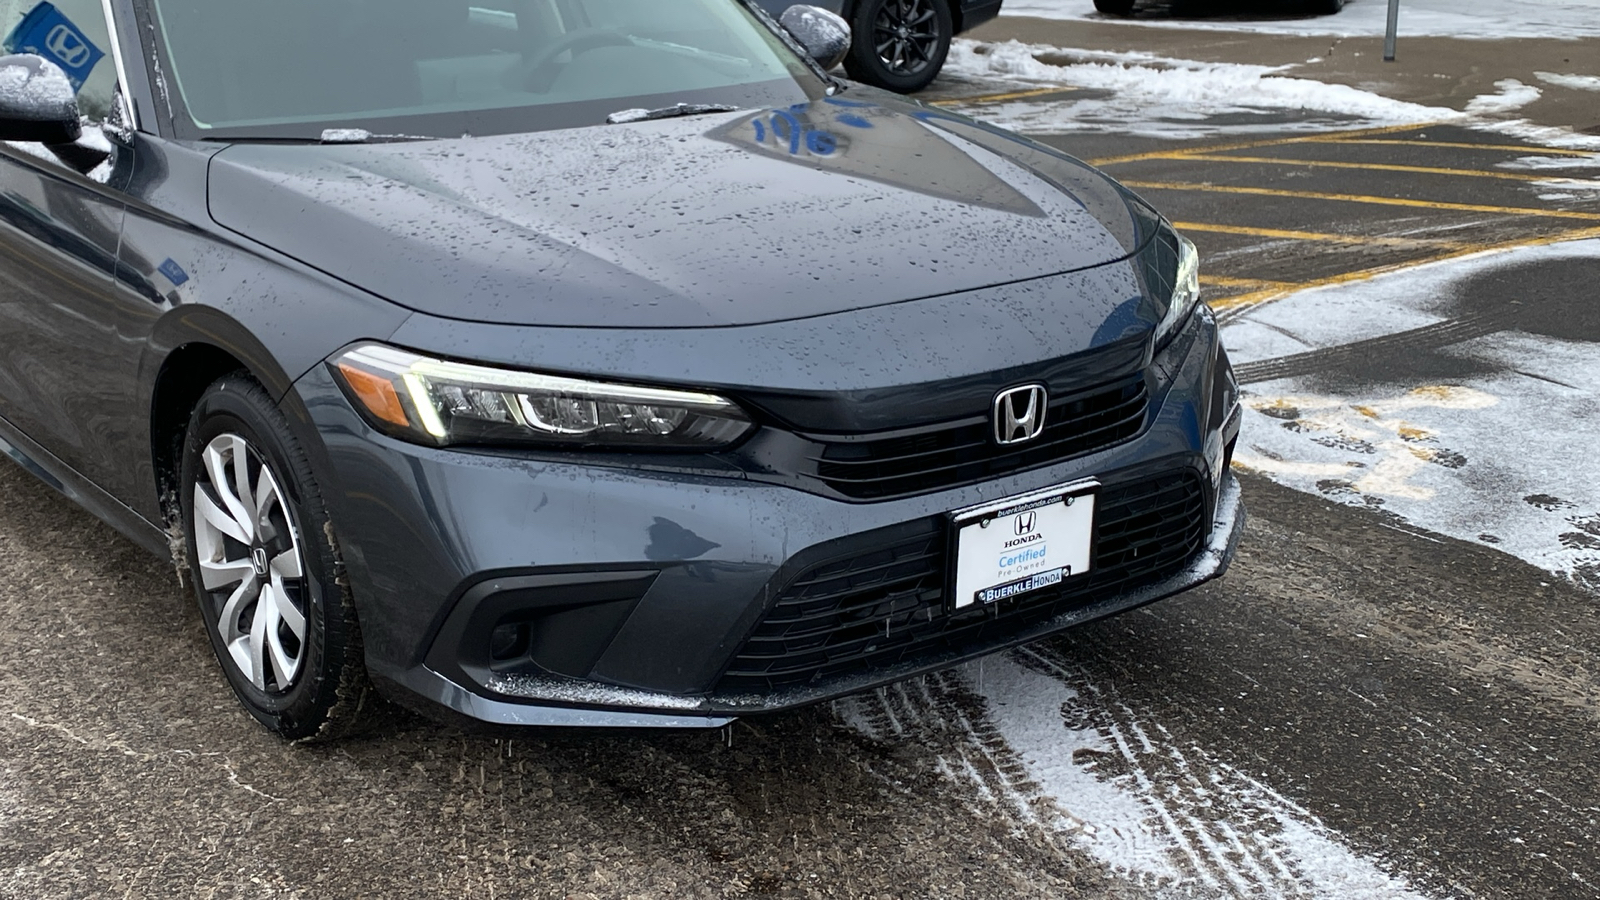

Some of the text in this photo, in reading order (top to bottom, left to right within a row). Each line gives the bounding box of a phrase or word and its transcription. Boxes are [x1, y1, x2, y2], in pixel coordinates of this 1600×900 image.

[997, 496, 1063, 518] buerklehonda.com
[1004, 533, 1042, 548] HONDA
[999, 545, 1046, 568] Certified
[998, 559, 1046, 578] Pre-Owned
[986, 573, 1060, 602] BUERKLE HONDA
